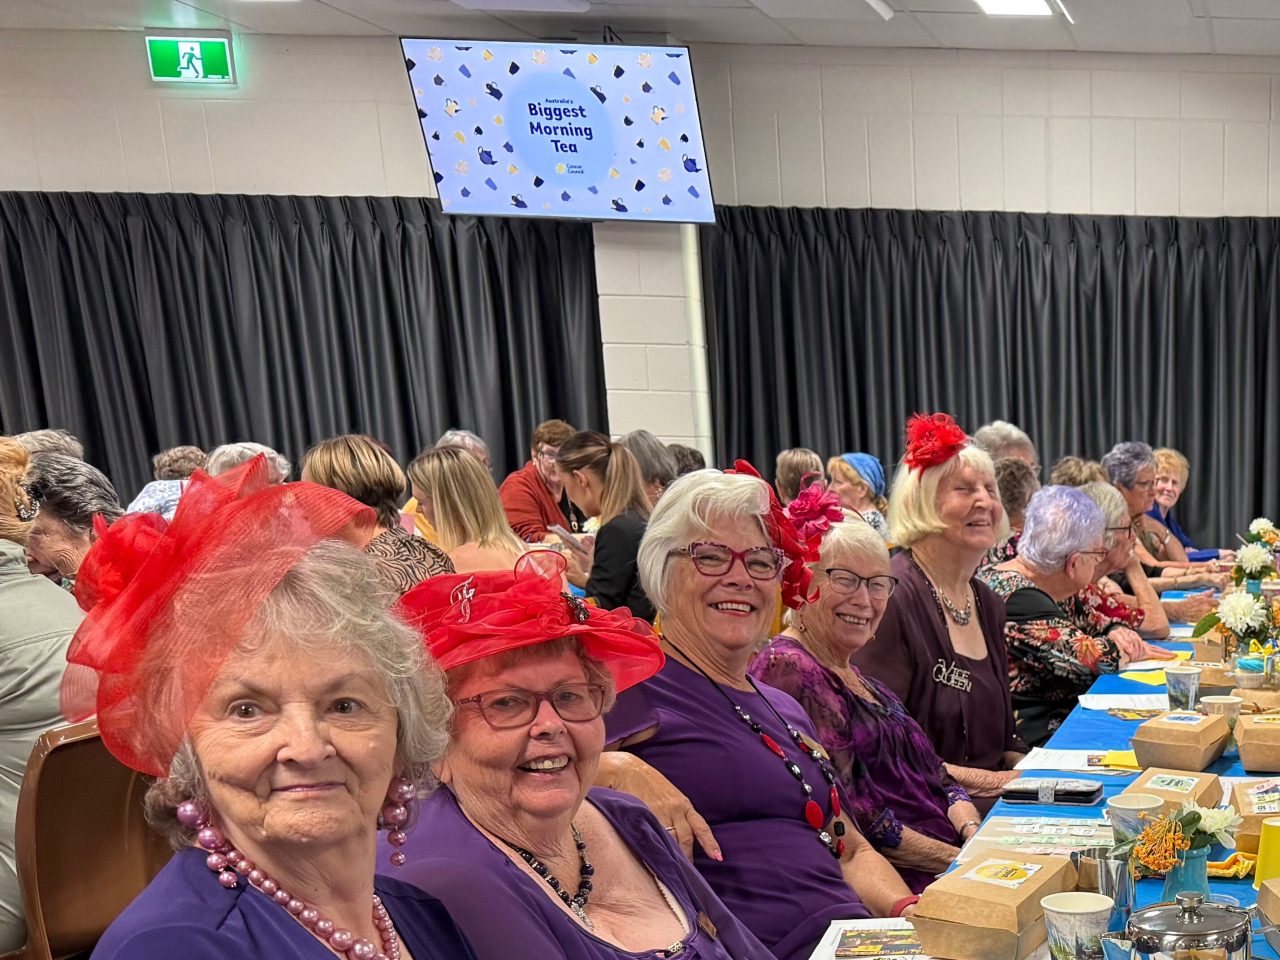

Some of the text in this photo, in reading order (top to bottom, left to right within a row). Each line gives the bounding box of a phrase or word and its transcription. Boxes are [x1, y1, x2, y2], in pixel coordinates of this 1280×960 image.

[527, 102, 587, 121] Biggest
[529, 121, 594, 141] Morning
[550, 139, 578, 153] Tea
